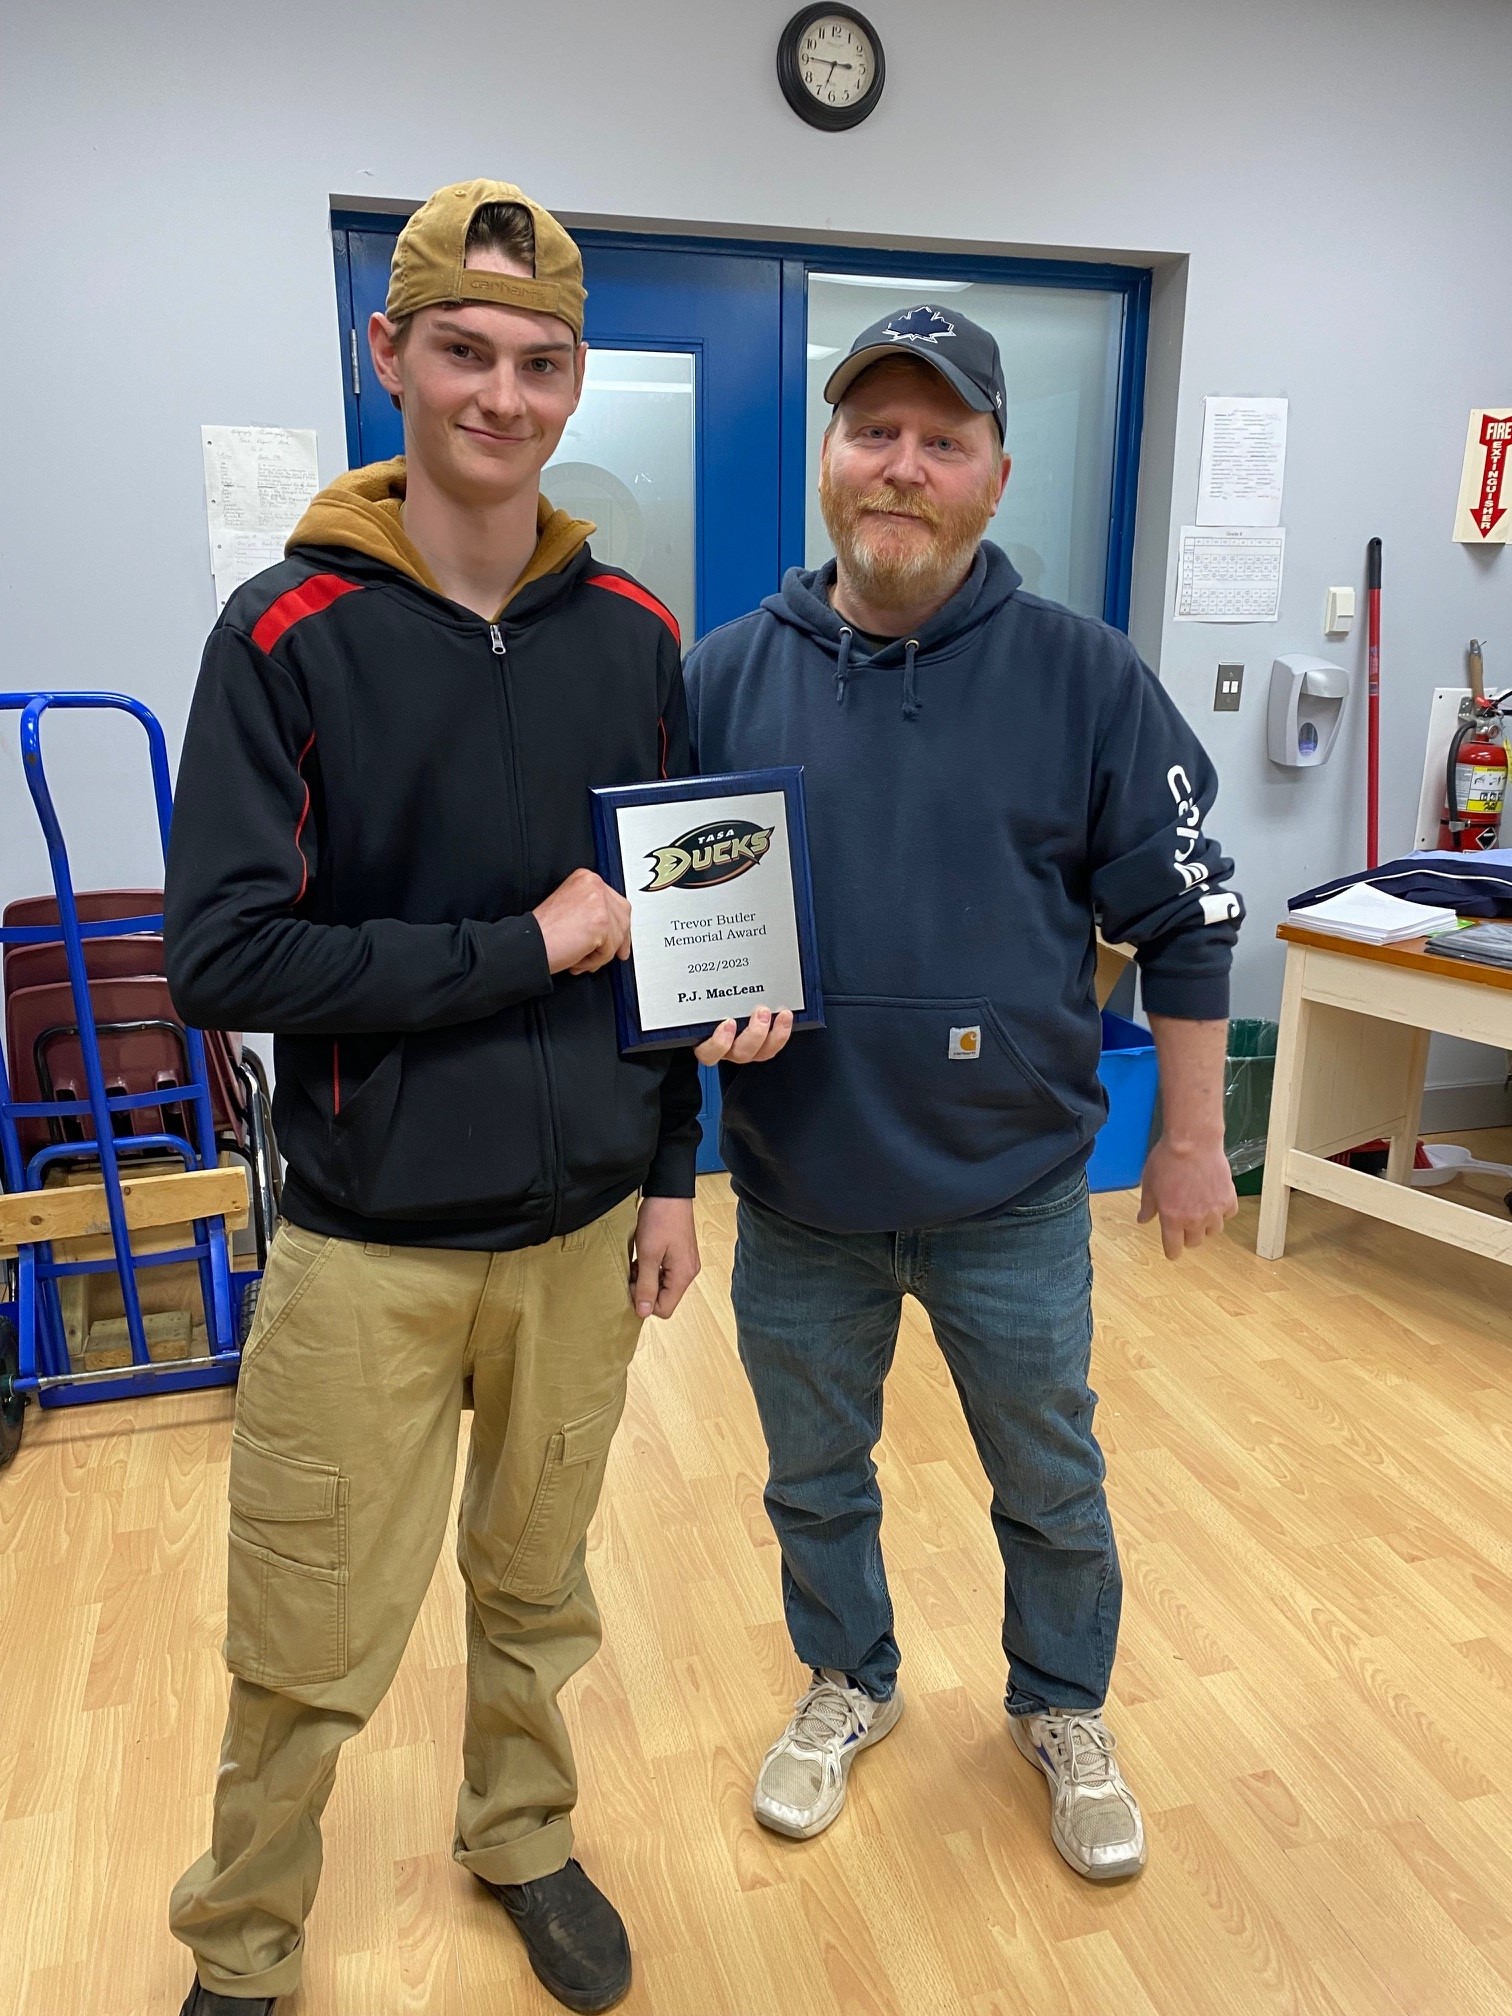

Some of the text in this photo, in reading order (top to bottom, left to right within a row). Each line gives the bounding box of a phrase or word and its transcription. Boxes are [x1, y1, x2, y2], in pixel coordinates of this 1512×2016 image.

[832, 26, 842, 38] 12
[807, 38, 817, 50] 10
[802, 53, 809, 65] 9
[805, 71, 812, 83] 8
[817, 85, 823, 95] 7
[828, 91, 835, 103] 6
[1486, 422, 1512, 440] FIRE
[1480, 440, 1503, 529] EXTINGUISHER
[697, 828, 735, 844] TASA
[640, 827, 774, 891] DUCKS
[670, 911, 756, 932] Trevor Butler
[663, 925, 767, 948] Memorial Award
[687, 957, 750, 974] 2022/2023
[677, 983, 765, 1003] P.J. MacLean
